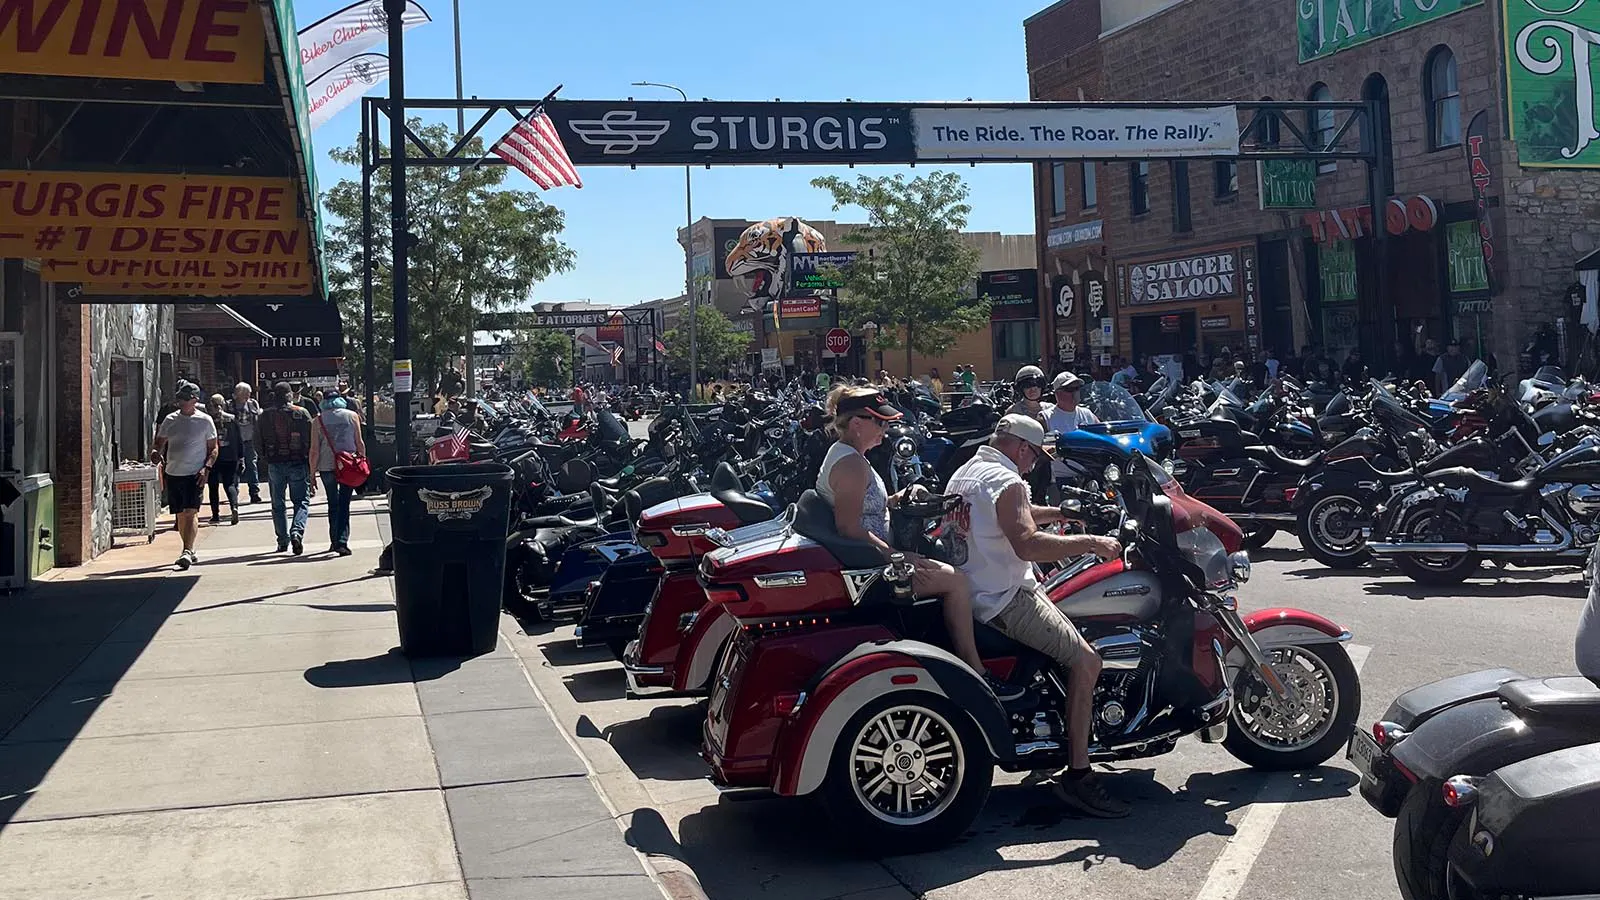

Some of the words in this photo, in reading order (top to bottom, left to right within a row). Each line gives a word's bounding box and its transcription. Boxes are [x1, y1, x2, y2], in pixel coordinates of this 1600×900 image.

[690, 116, 887, 150] STURGIS
[933, 126, 969, 142] The
[975, 126, 1025, 142] Ride.
[1030, 126, 1066, 142] The
[1071, 126, 1119, 142] Roar.
[1125, 125, 1159, 141] The
[1164, 124, 1213, 142] Rally.
[179, 184, 284, 221] FIRE
[34, 225, 93, 252] #1
[110, 226, 298, 256] DESIGN
[1145, 254, 1235, 282] STINGER
[1146, 274, 1235, 301] SALOON
[1245, 258, 1256, 327] CIGARS
[546, 314, 605, 325] ATTORNEYS
[827, 336, 849, 346] STOP
[282, 370, 308, 378] GIFTS
